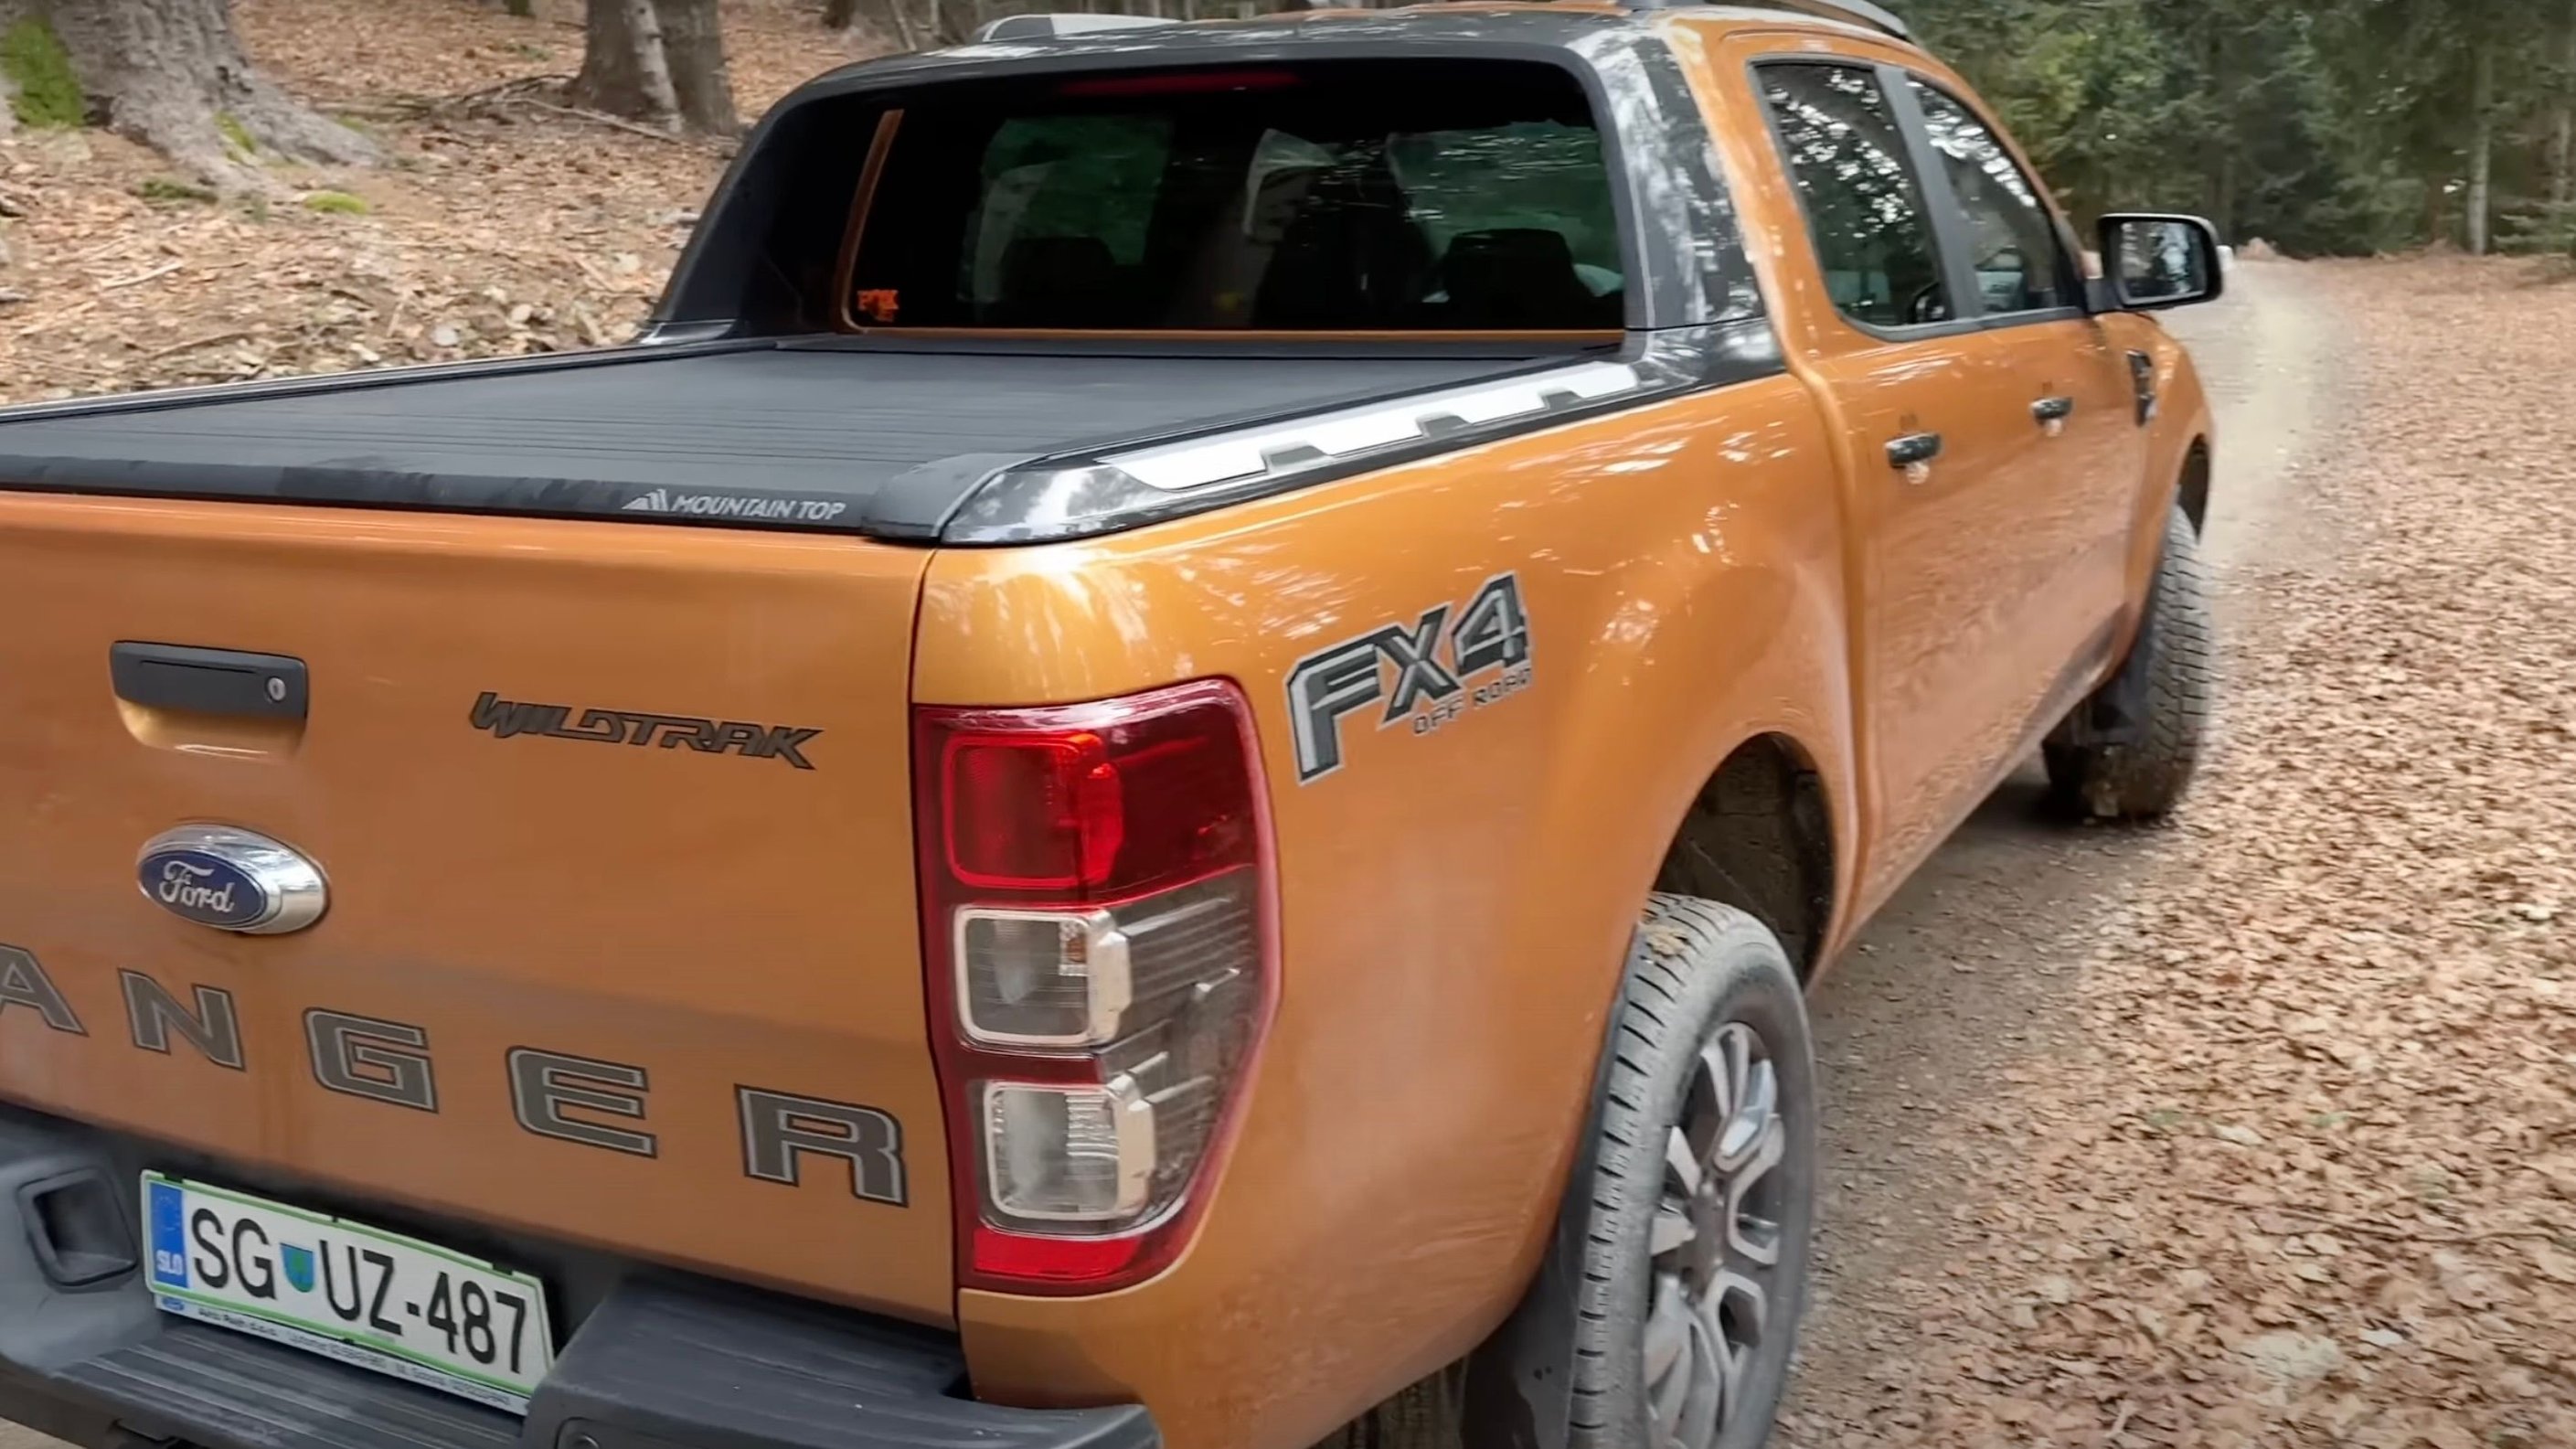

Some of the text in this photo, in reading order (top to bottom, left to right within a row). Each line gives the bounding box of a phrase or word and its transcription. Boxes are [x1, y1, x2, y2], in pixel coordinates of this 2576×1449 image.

[671, 495, 846, 520] MOUNTAIN TOP
[1283, 570, 1531, 786] FX4
[1414, 666, 1532, 734] OFF ROAD
[469, 691, 825, 771] WILDTRAK
[159, 860, 236, 913] Ford
[156, 1249, 185, 1276] SLO
[191, 1208, 278, 1301] SG
[320, 1240, 527, 1374] UZ-487
